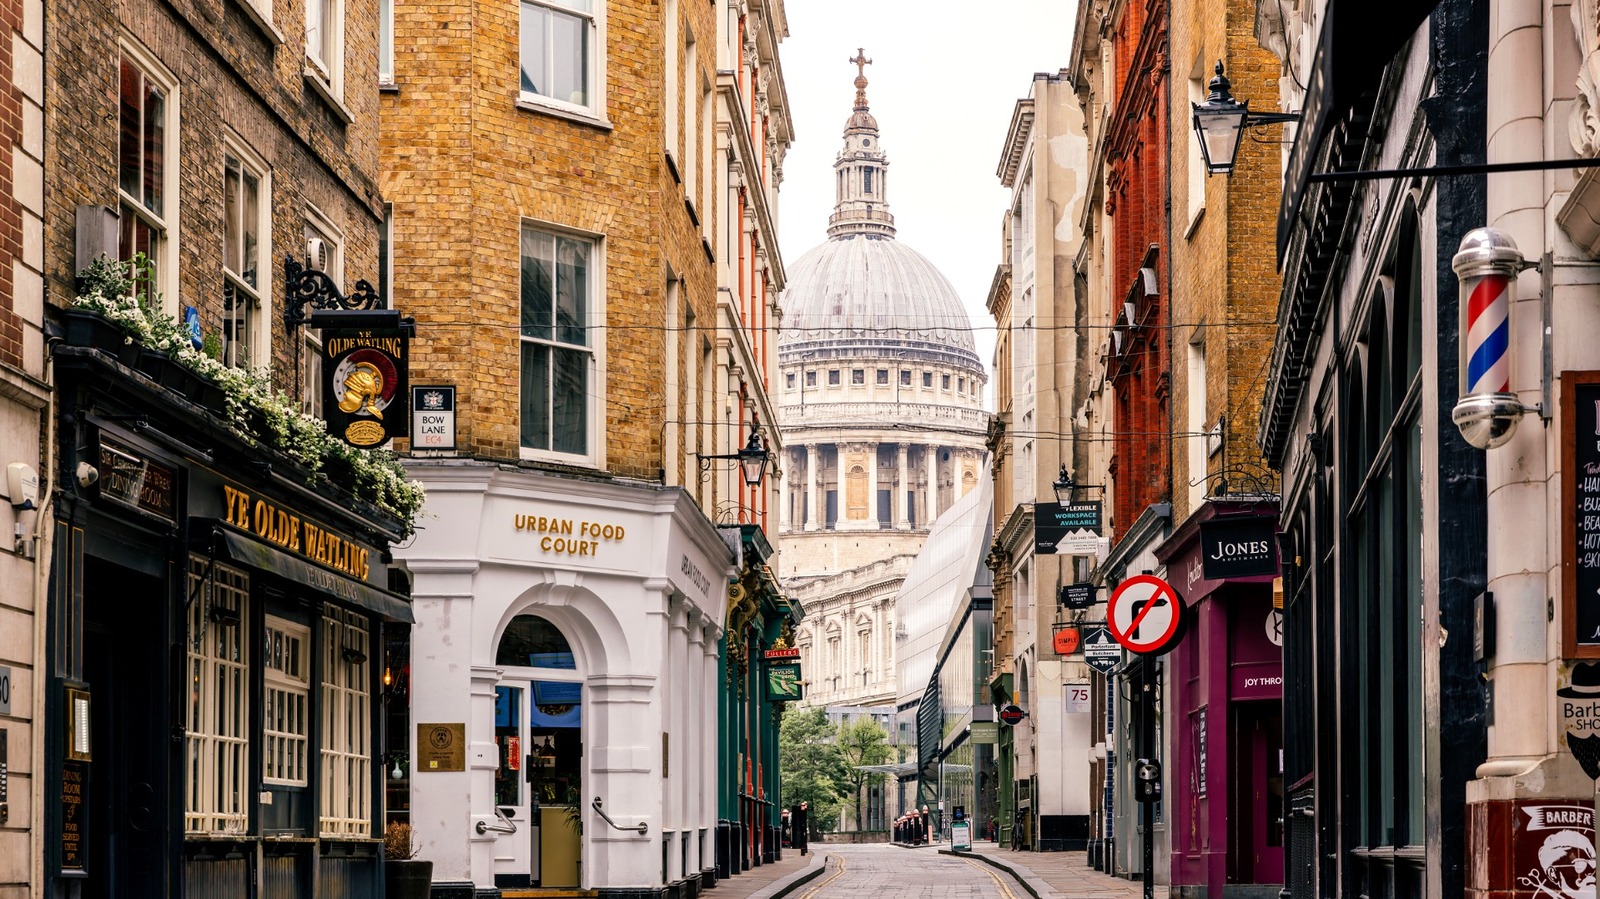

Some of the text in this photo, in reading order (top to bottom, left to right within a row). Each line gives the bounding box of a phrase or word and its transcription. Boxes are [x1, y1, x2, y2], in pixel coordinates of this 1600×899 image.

[328, 337, 401, 358] OLDE WATLING
[422, 416, 445, 424] BOW
[421, 426, 446, 434] LANE
[425, 436, 442, 444] EC4
[112, 472, 138, 498] DINING
[224, 485, 369, 582] YE OLDE WATLING
[514, 514, 625, 541] URBAN FOOD
[540, 536, 599, 556] COURT
[1211, 541, 1268, 559] JONES
[1244, 678, 1258, 688] JOY
[0, 676, 9, 704] 0
[1072, 690, 1088, 701] 75
[1564, 702, 1600, 718] Barb
[62, 769, 81, 782] DINING
[64, 782, 80, 794] ROOM
[1546, 811, 1591, 825] BARBER
[65, 823, 77, 831] FOOD
[62, 833, 79, 841] SERVED
[64, 843, 78, 851] UNTIL
